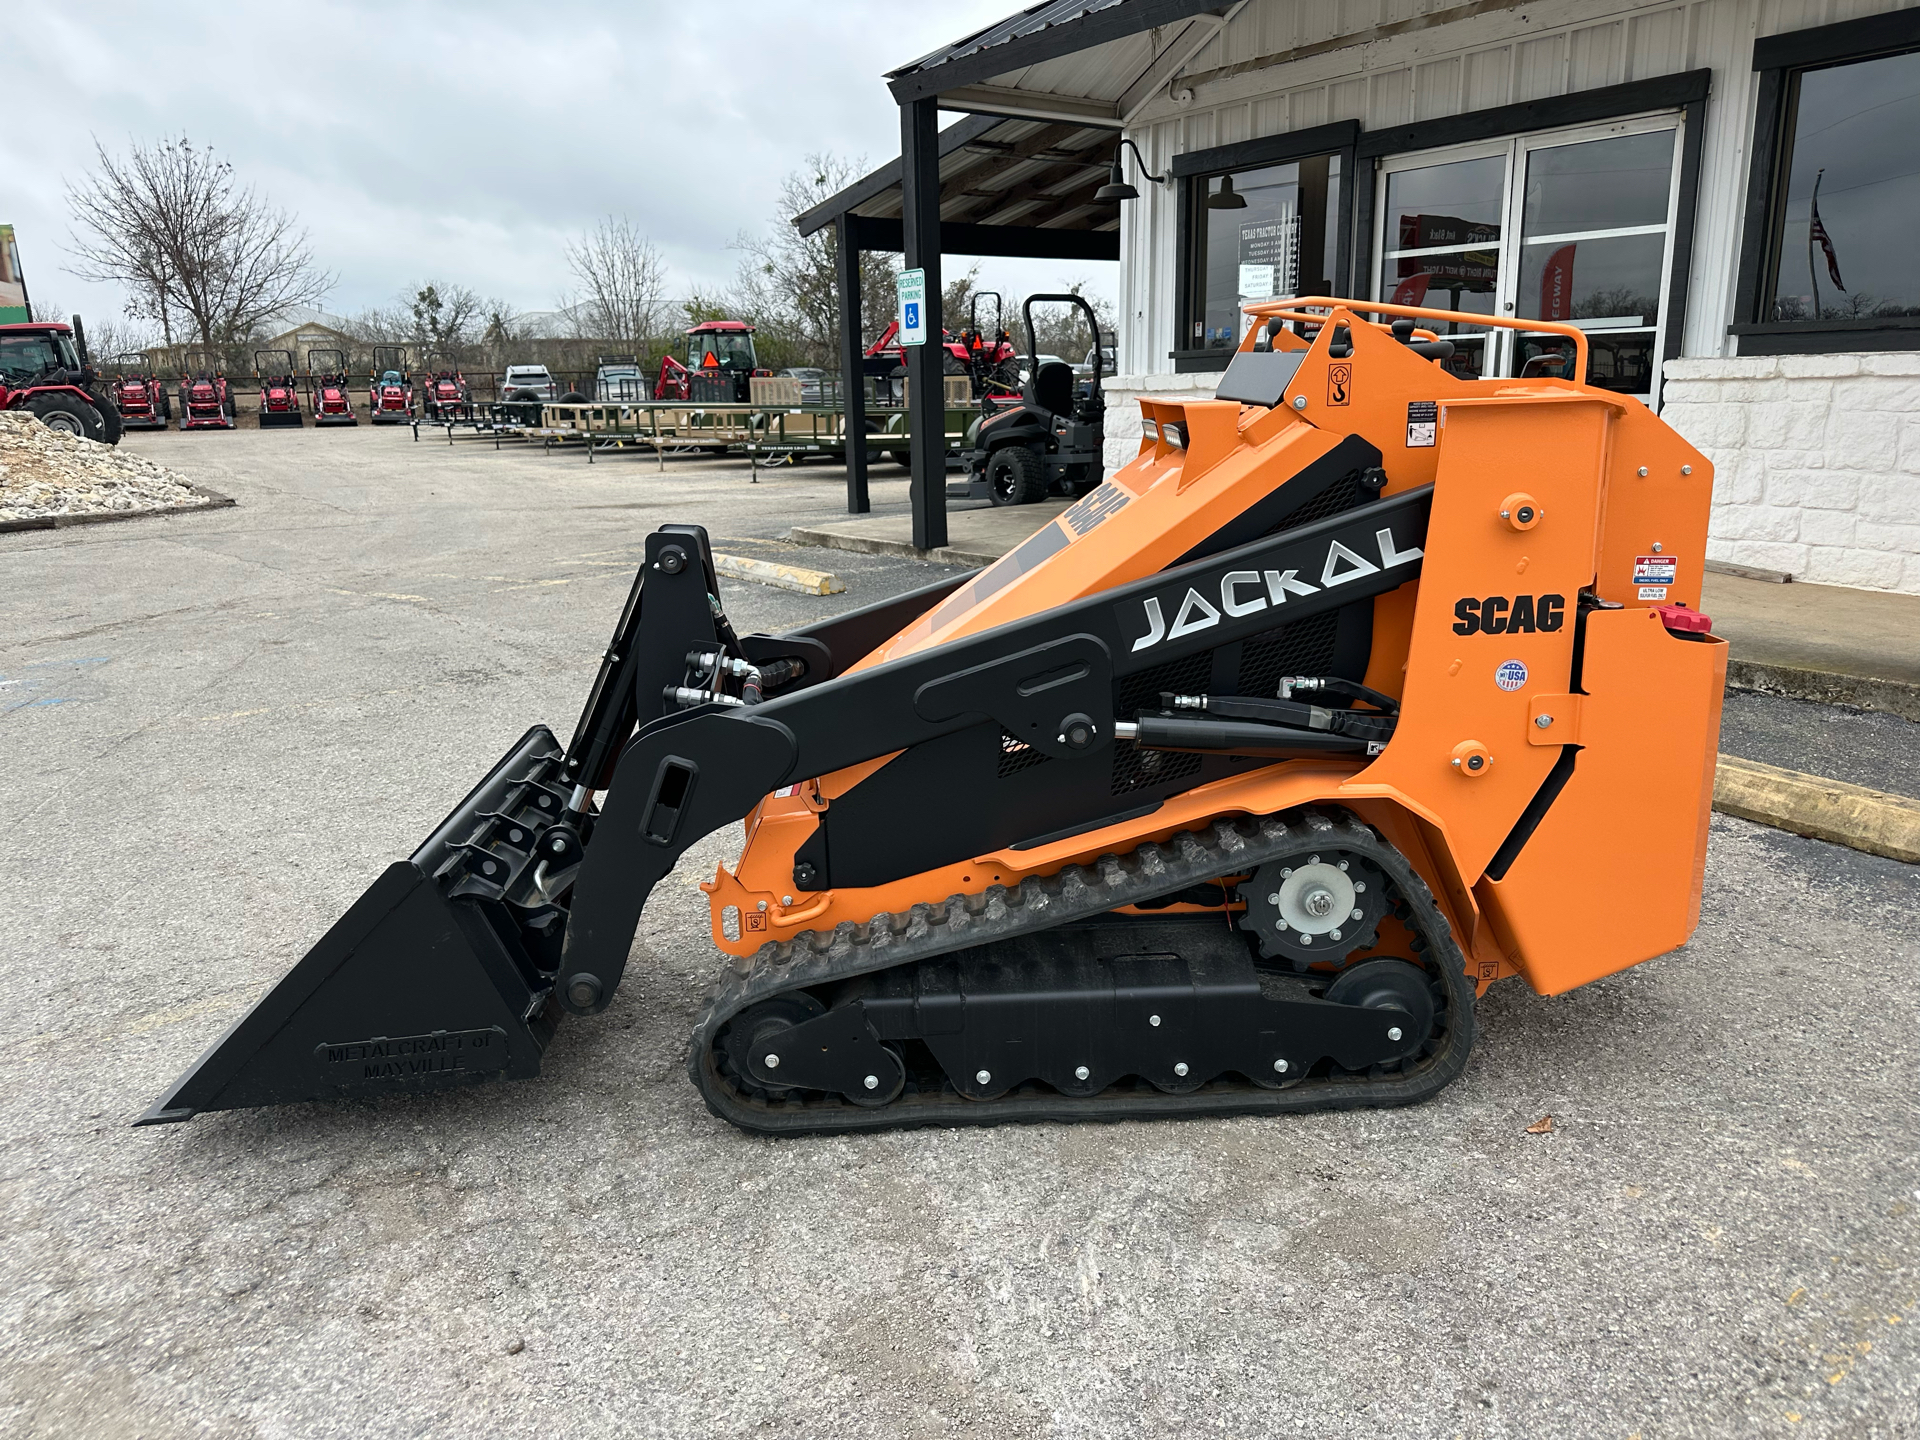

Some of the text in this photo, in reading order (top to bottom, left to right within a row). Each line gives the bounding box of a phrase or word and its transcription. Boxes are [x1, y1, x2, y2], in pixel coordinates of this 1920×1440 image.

[1242, 229, 1256, 240] TEXAS
[899, 277, 922, 289] RESERVED
[902, 289, 921, 301] PARKING
[1551, 266, 1563, 321] EGWAY
[1064, 482, 1130, 536] SCAG
[1131, 528, 1424, 653] JACKAL
[1453, 594, 1565, 636] SCAG
[1507, 671, 1526, 682] USA
[328, 1033, 493, 1064] METALCRAFT of
[364, 1055, 465, 1080] MAYVILLE
